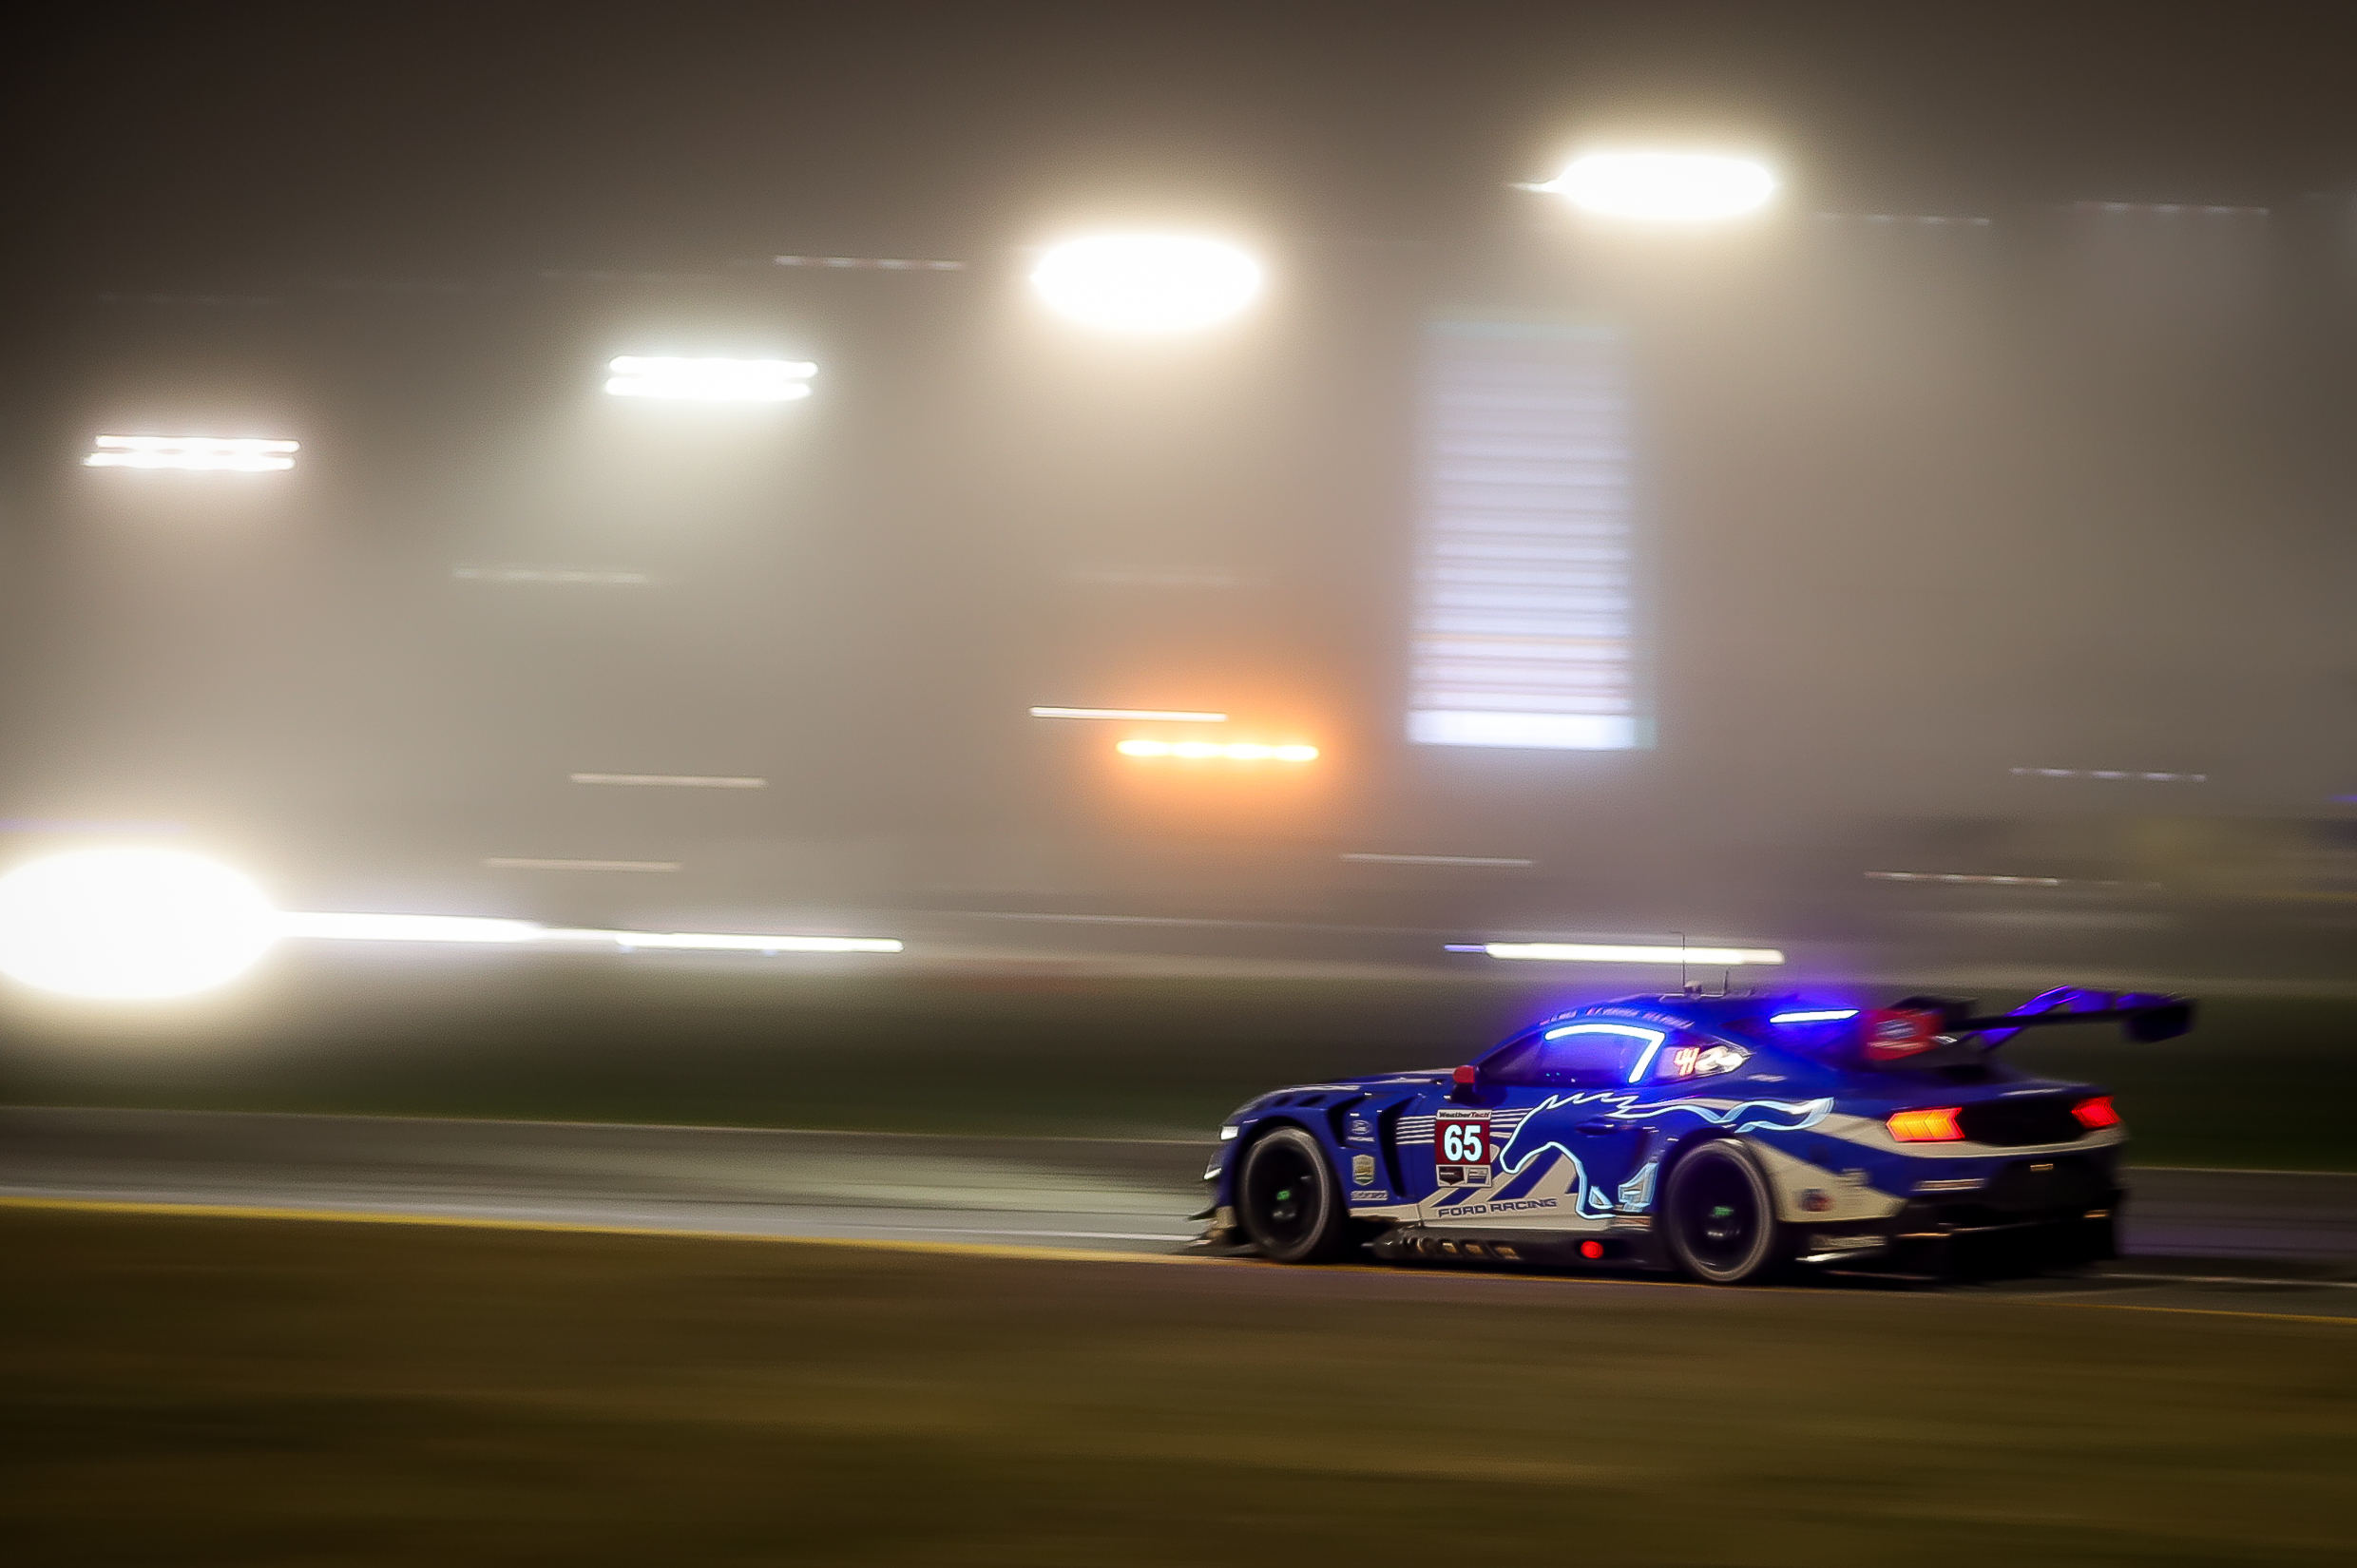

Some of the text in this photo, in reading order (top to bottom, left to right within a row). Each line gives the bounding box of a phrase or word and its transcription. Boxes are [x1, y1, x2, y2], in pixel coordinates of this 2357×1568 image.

[1444, 1124, 1483, 1162] 65
[1438, 1197, 1558, 1217] FORD RACING
